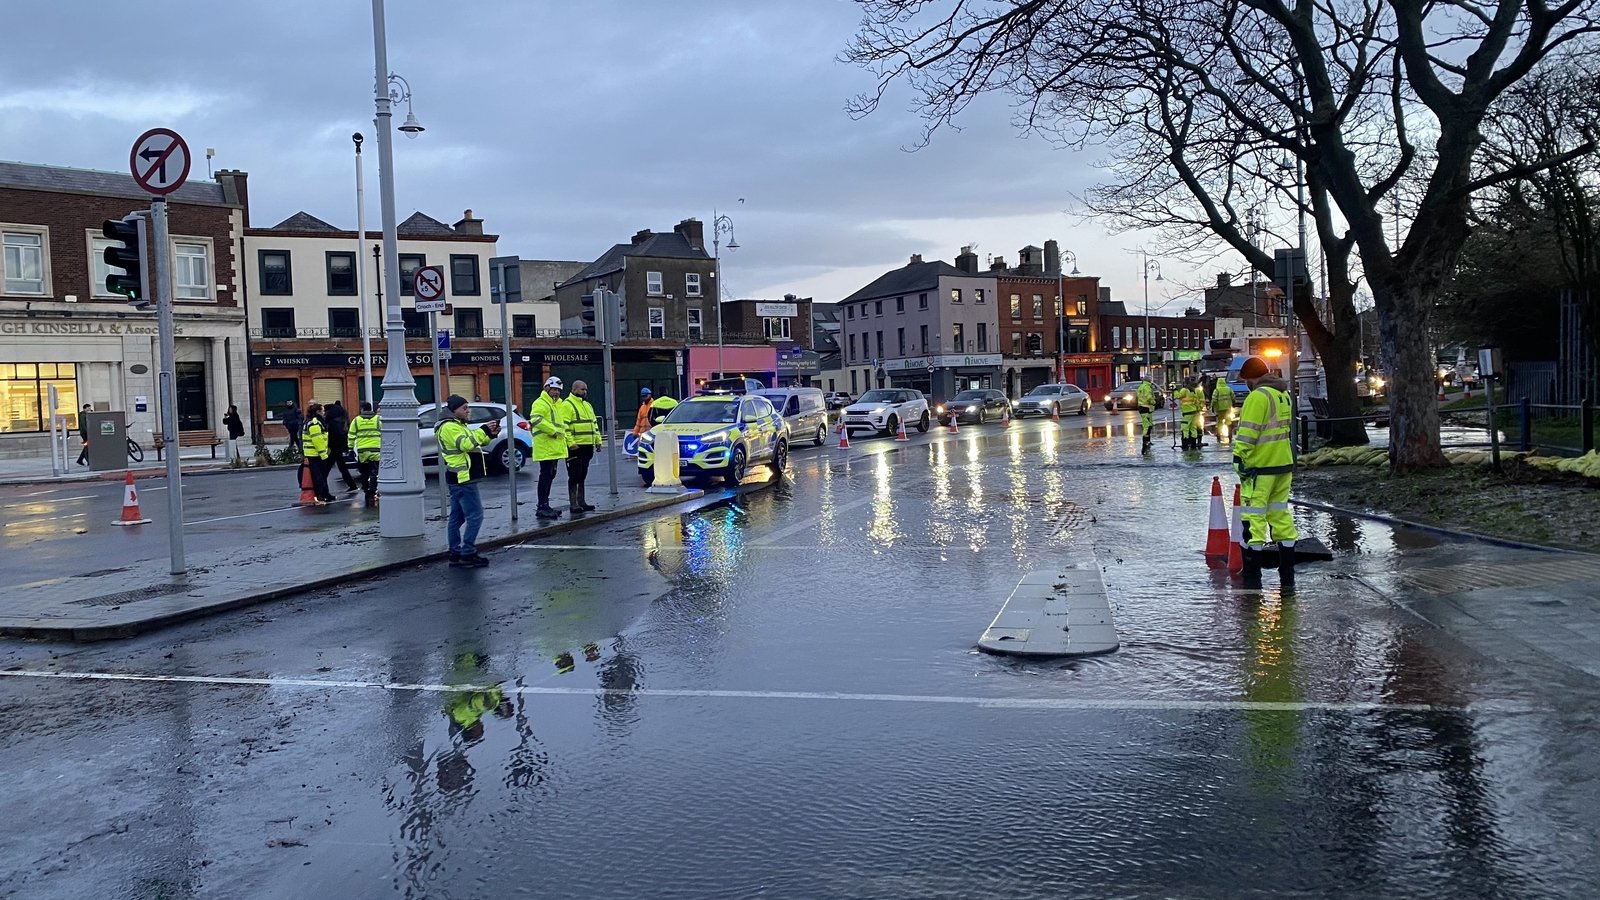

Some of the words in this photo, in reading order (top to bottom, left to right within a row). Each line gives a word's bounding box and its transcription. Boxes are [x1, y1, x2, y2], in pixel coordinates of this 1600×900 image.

[0, 322, 27, 334] GH
[32, 322, 106, 334] KINSELLA
[109, 323, 121, 334] &
[125, 323, 183, 335] Assoces
[264, 357, 271, 366] 5
[543, 354, 589, 362] WHOLESALE
